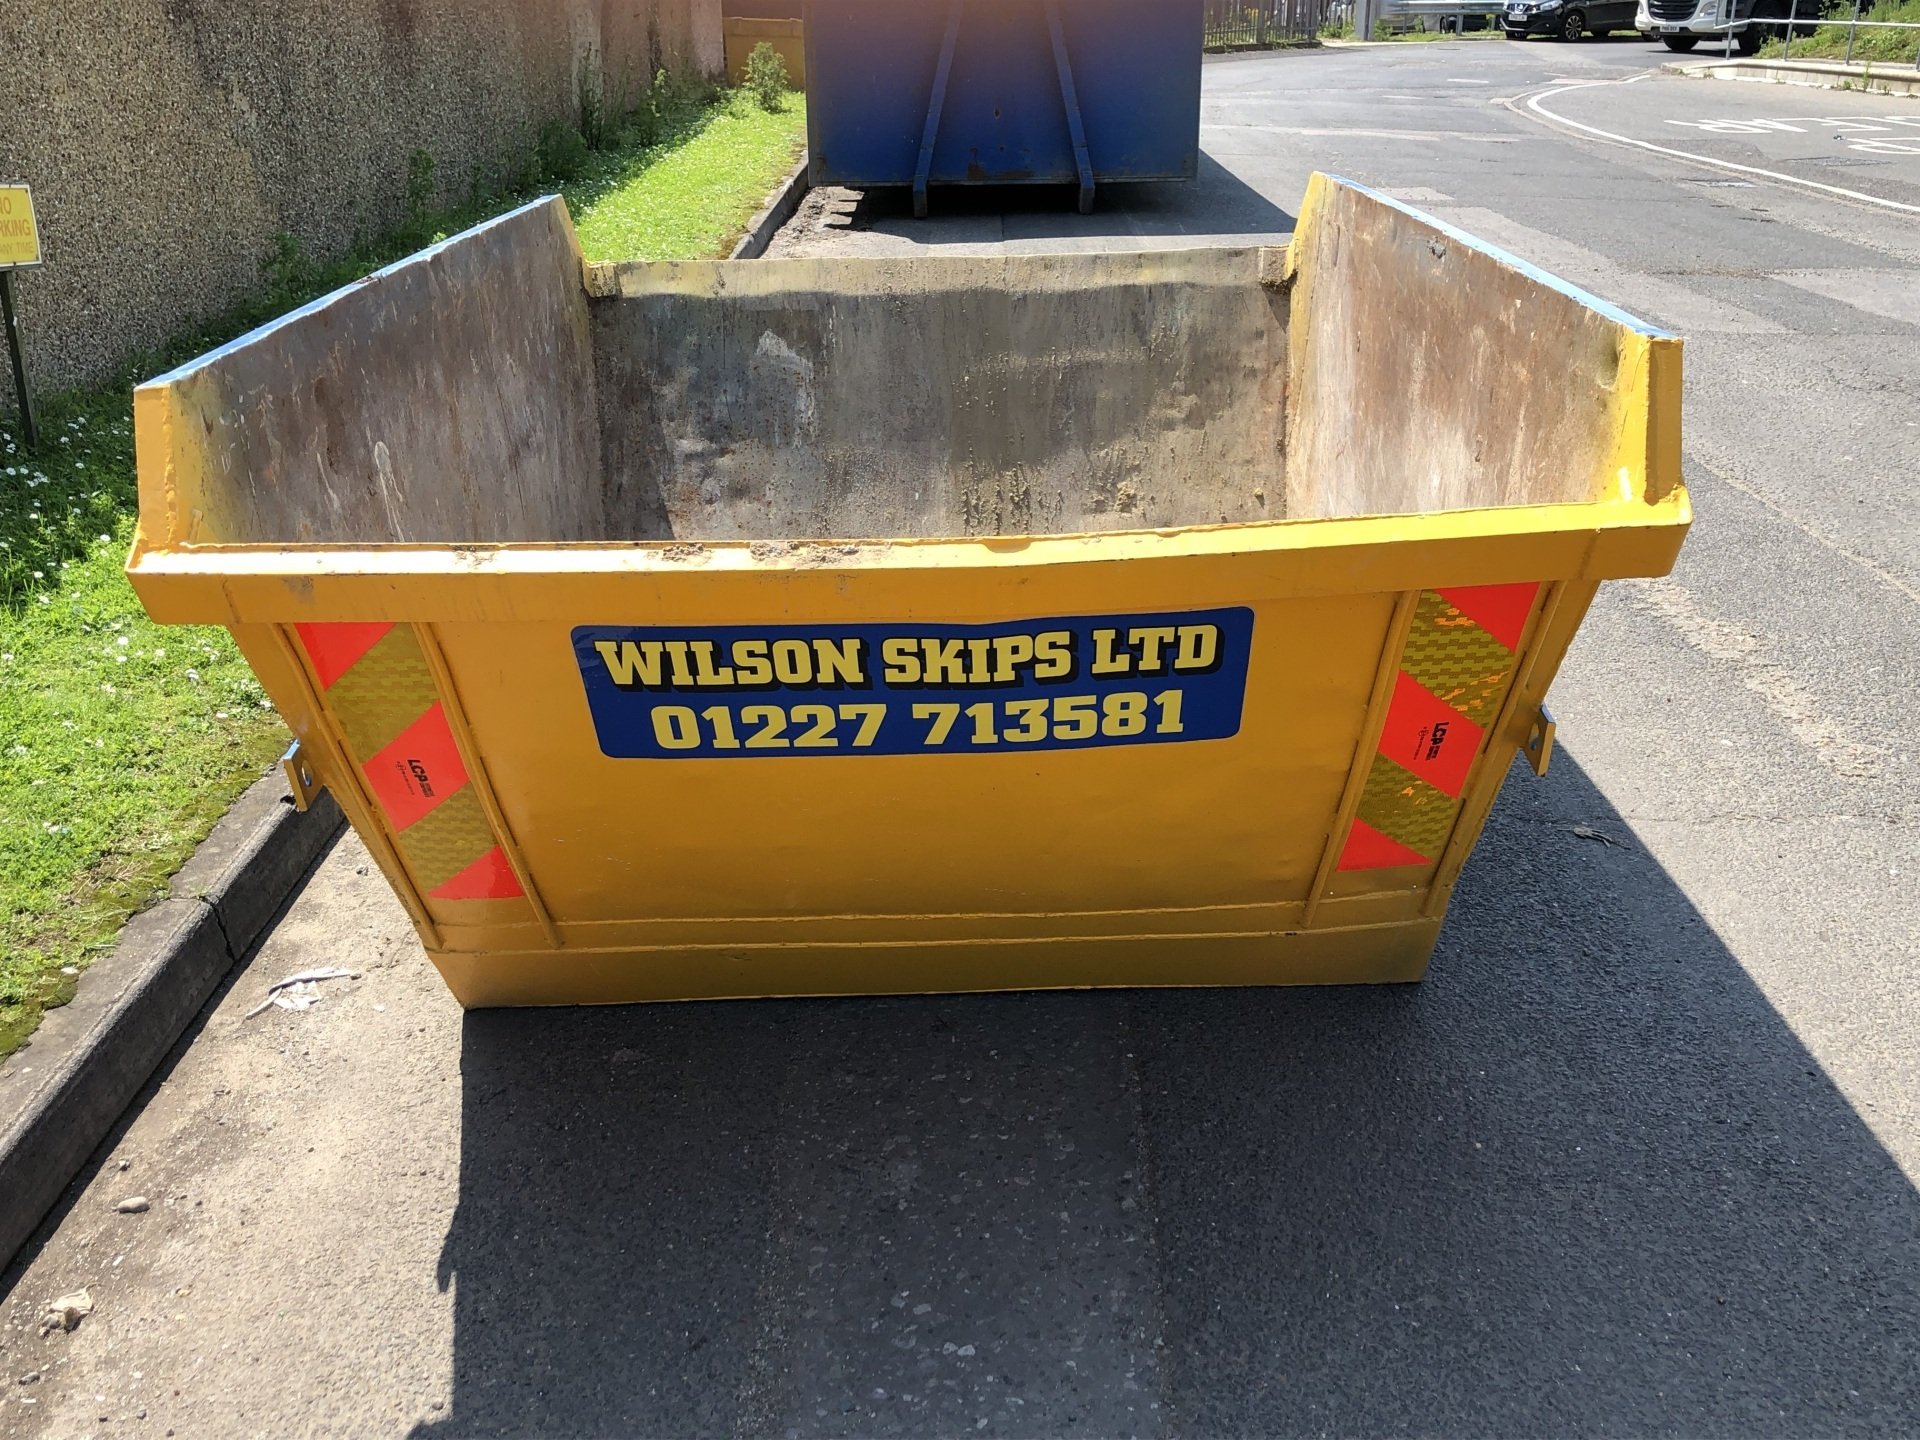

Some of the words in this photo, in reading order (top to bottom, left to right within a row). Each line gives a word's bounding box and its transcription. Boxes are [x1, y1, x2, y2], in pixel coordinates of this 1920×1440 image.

[593, 637, 867, 687] WILSON
[881, 630, 1073, 684] SKIPS
[1091, 623, 1219, 675] LTD
[650, 703, 888, 750] 01227
[911, 688, 1184, 746] 713581
[1430, 721, 1449, 745] LCP
[407, 759, 429, 782] LCP
